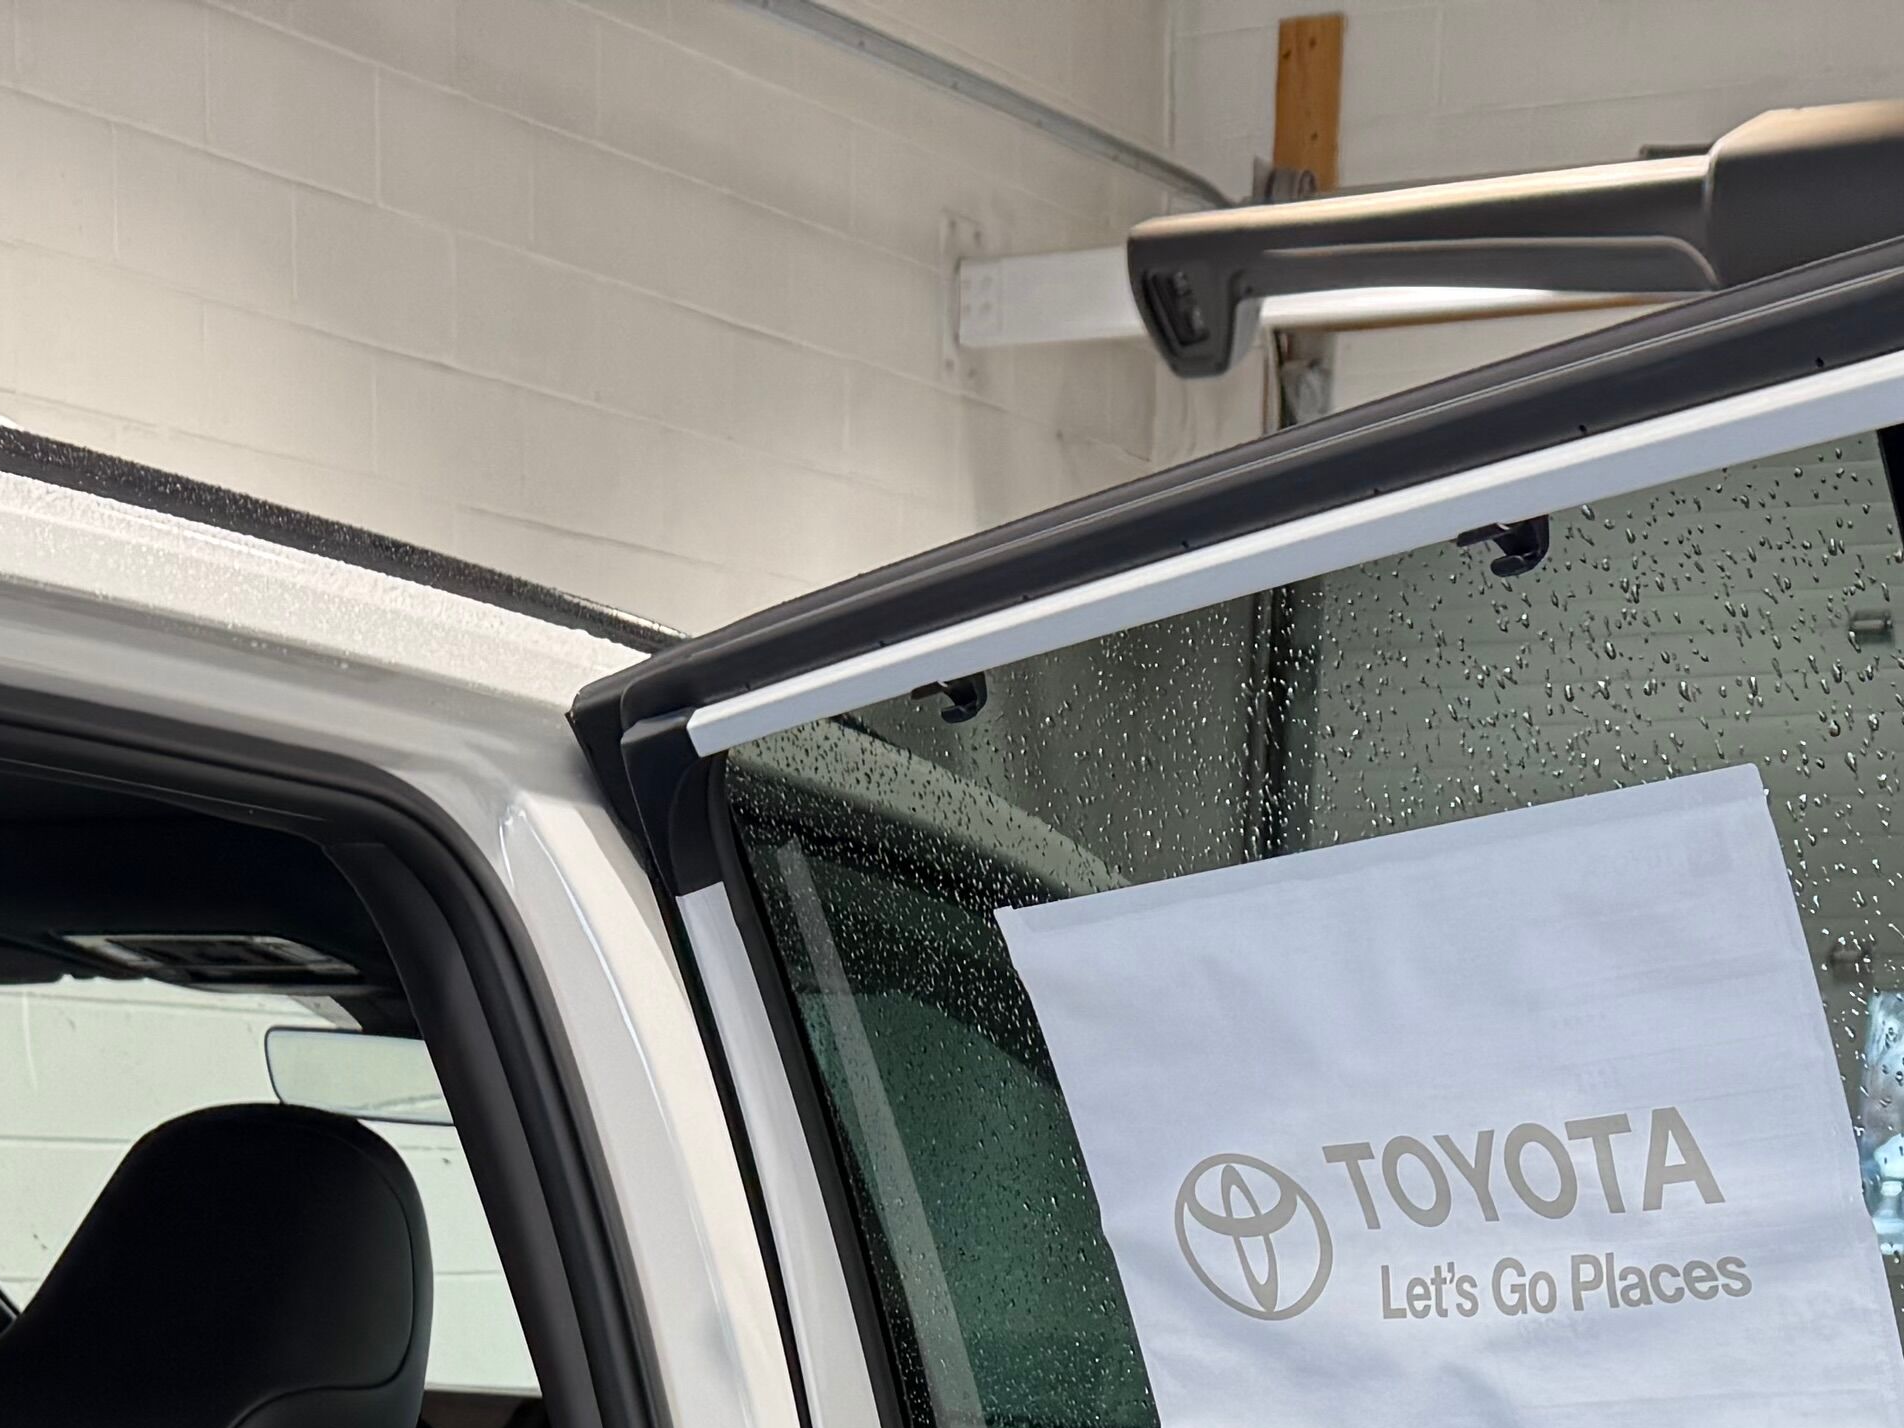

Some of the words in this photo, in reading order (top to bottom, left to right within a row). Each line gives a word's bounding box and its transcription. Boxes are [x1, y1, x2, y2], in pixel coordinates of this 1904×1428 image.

[1322, 1106, 1726, 1231] TOYOTA
[1380, 1259, 1478, 1322] Let's
[1491, 1255, 1558, 1317] Go
[1572, 1249, 1754, 1311] Places
